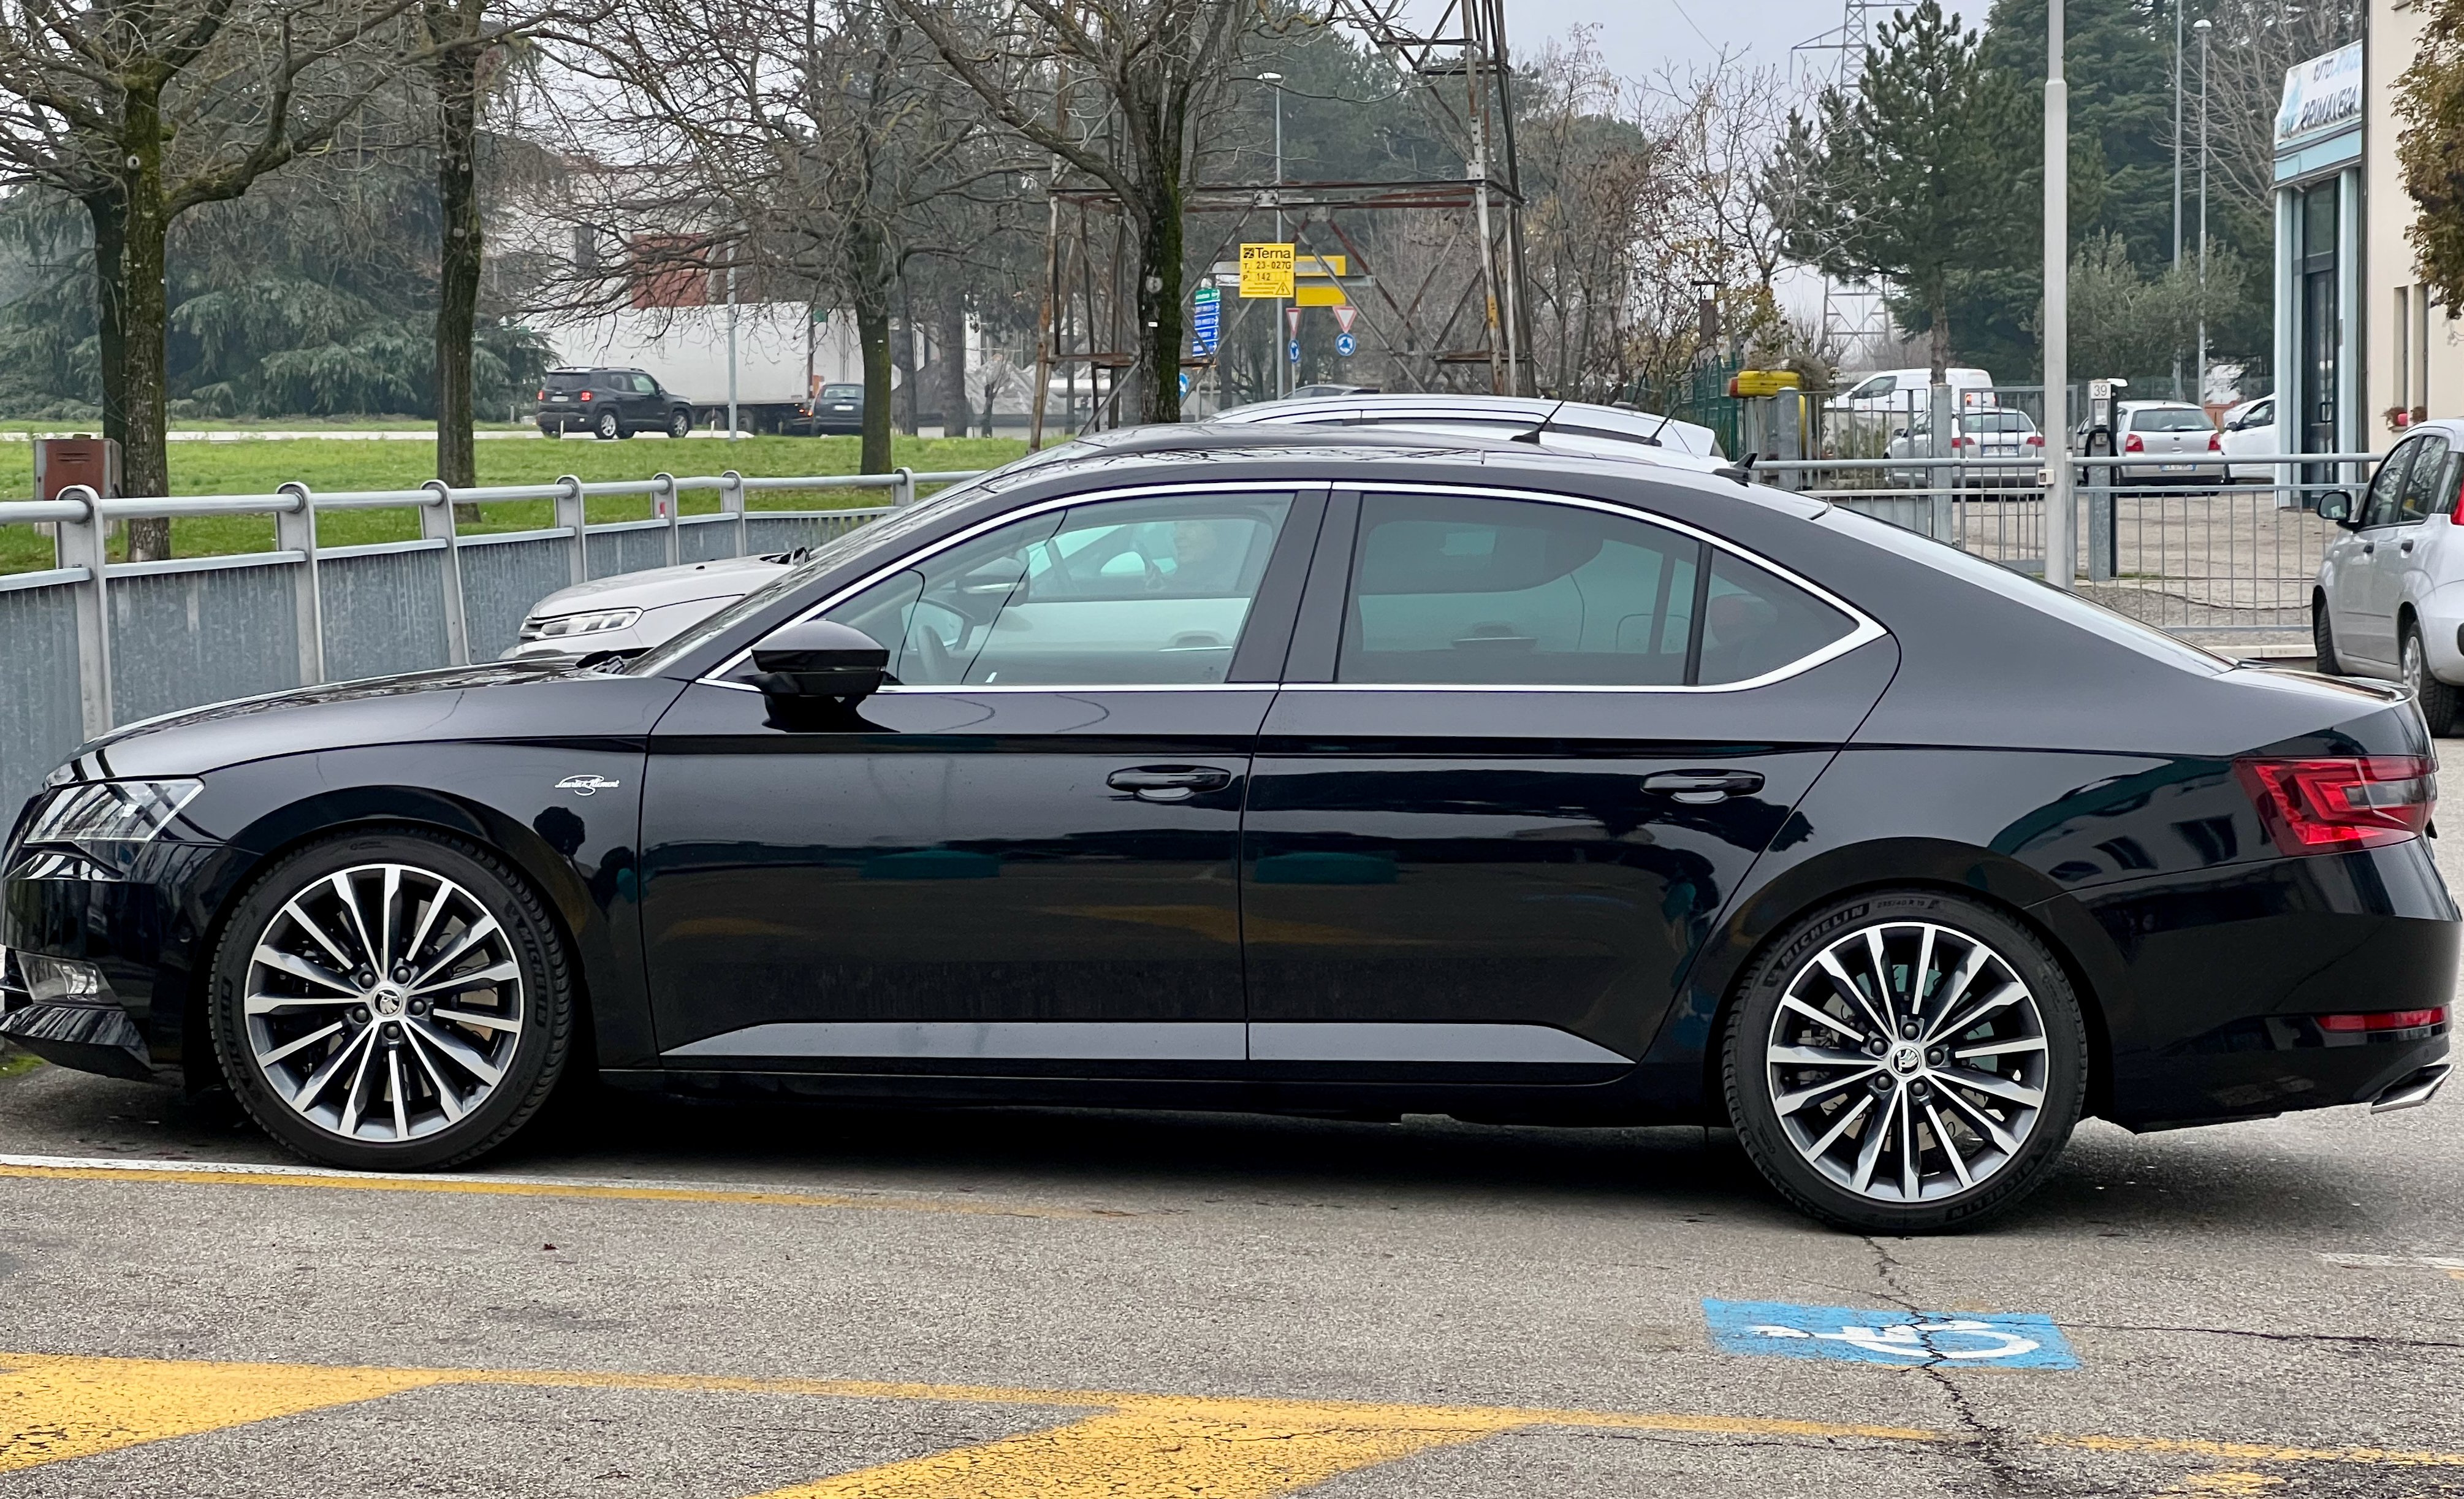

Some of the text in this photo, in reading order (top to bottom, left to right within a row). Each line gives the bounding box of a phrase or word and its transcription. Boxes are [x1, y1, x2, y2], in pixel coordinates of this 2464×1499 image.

[1255, 247, 1291, 259] Terna
[1257, 261, 1291, 270] 23-027G
[2094, 384, 2107, 397] 39
[1781, 905, 1864, 966] MICHELIN
